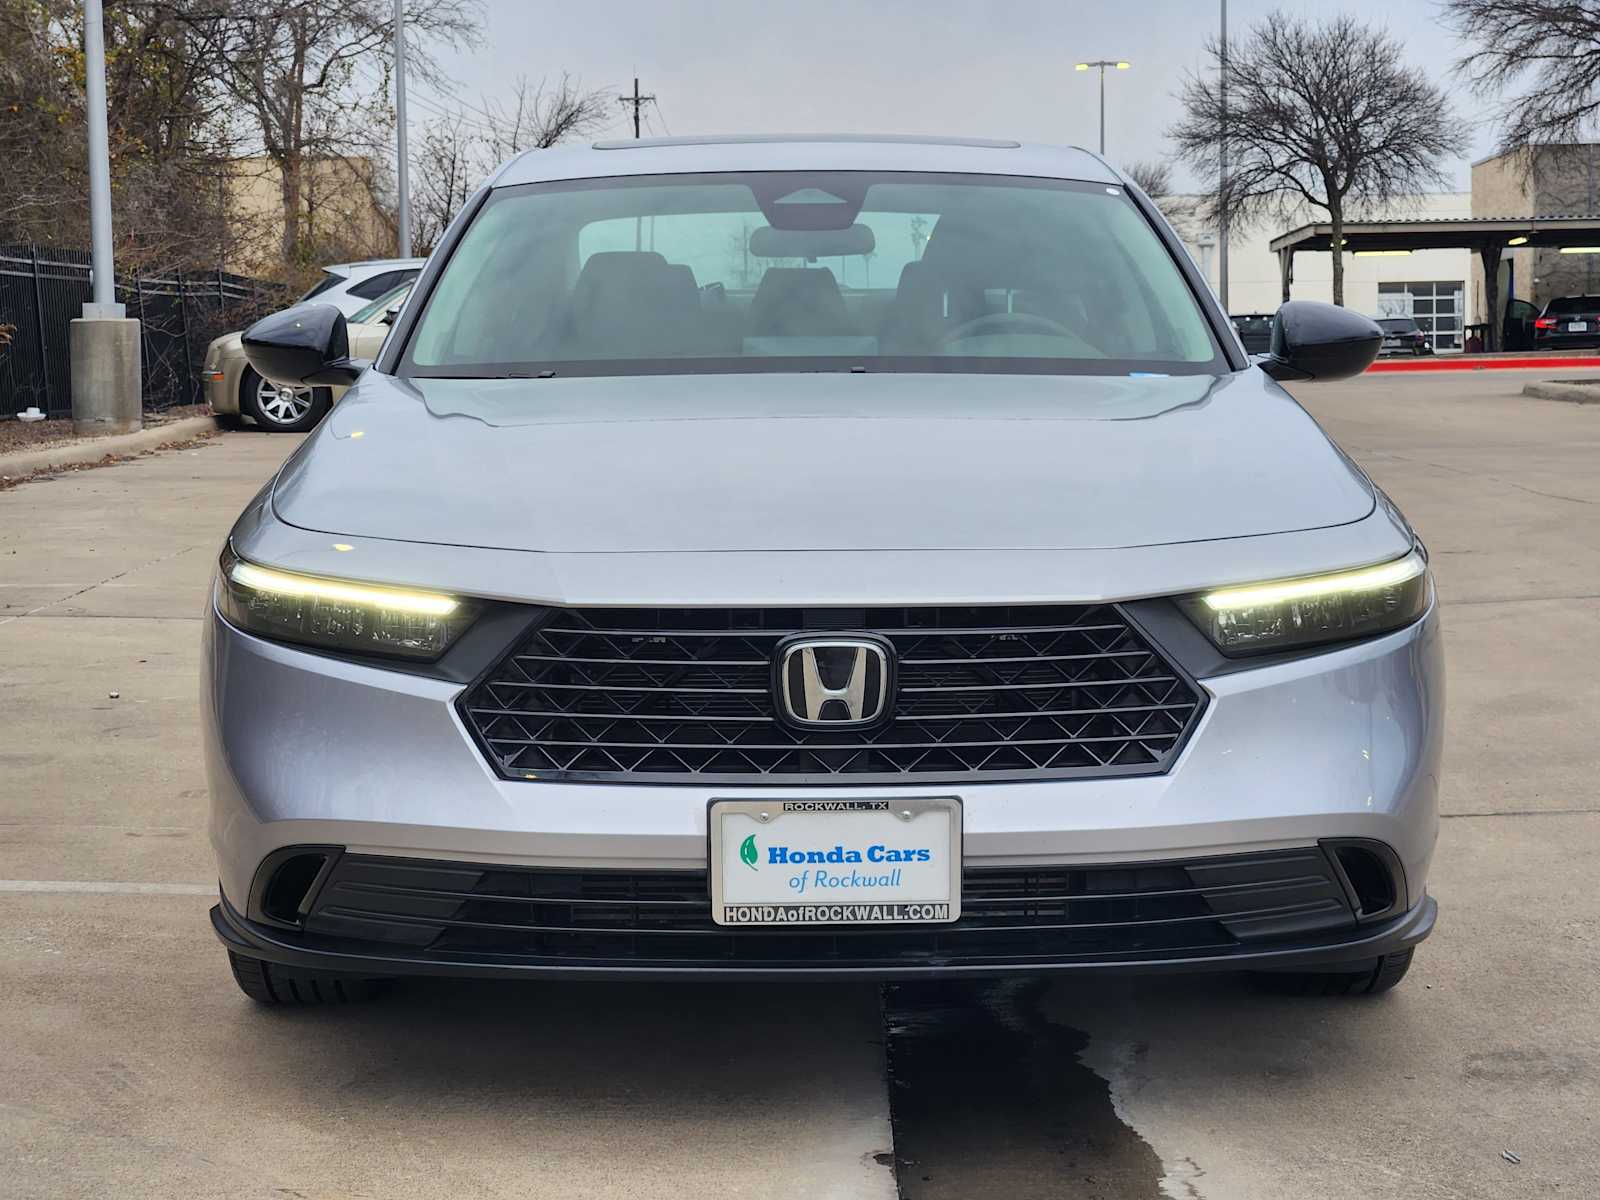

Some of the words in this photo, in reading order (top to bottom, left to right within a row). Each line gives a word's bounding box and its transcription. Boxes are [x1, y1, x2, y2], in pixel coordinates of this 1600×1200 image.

[869, 802, 888, 811] TX
[768, 846, 862, 864] Honda
[867, 845, 930, 863] Cars
[788, 870, 810, 893] of
[814, 868, 901, 888] Rockwall
